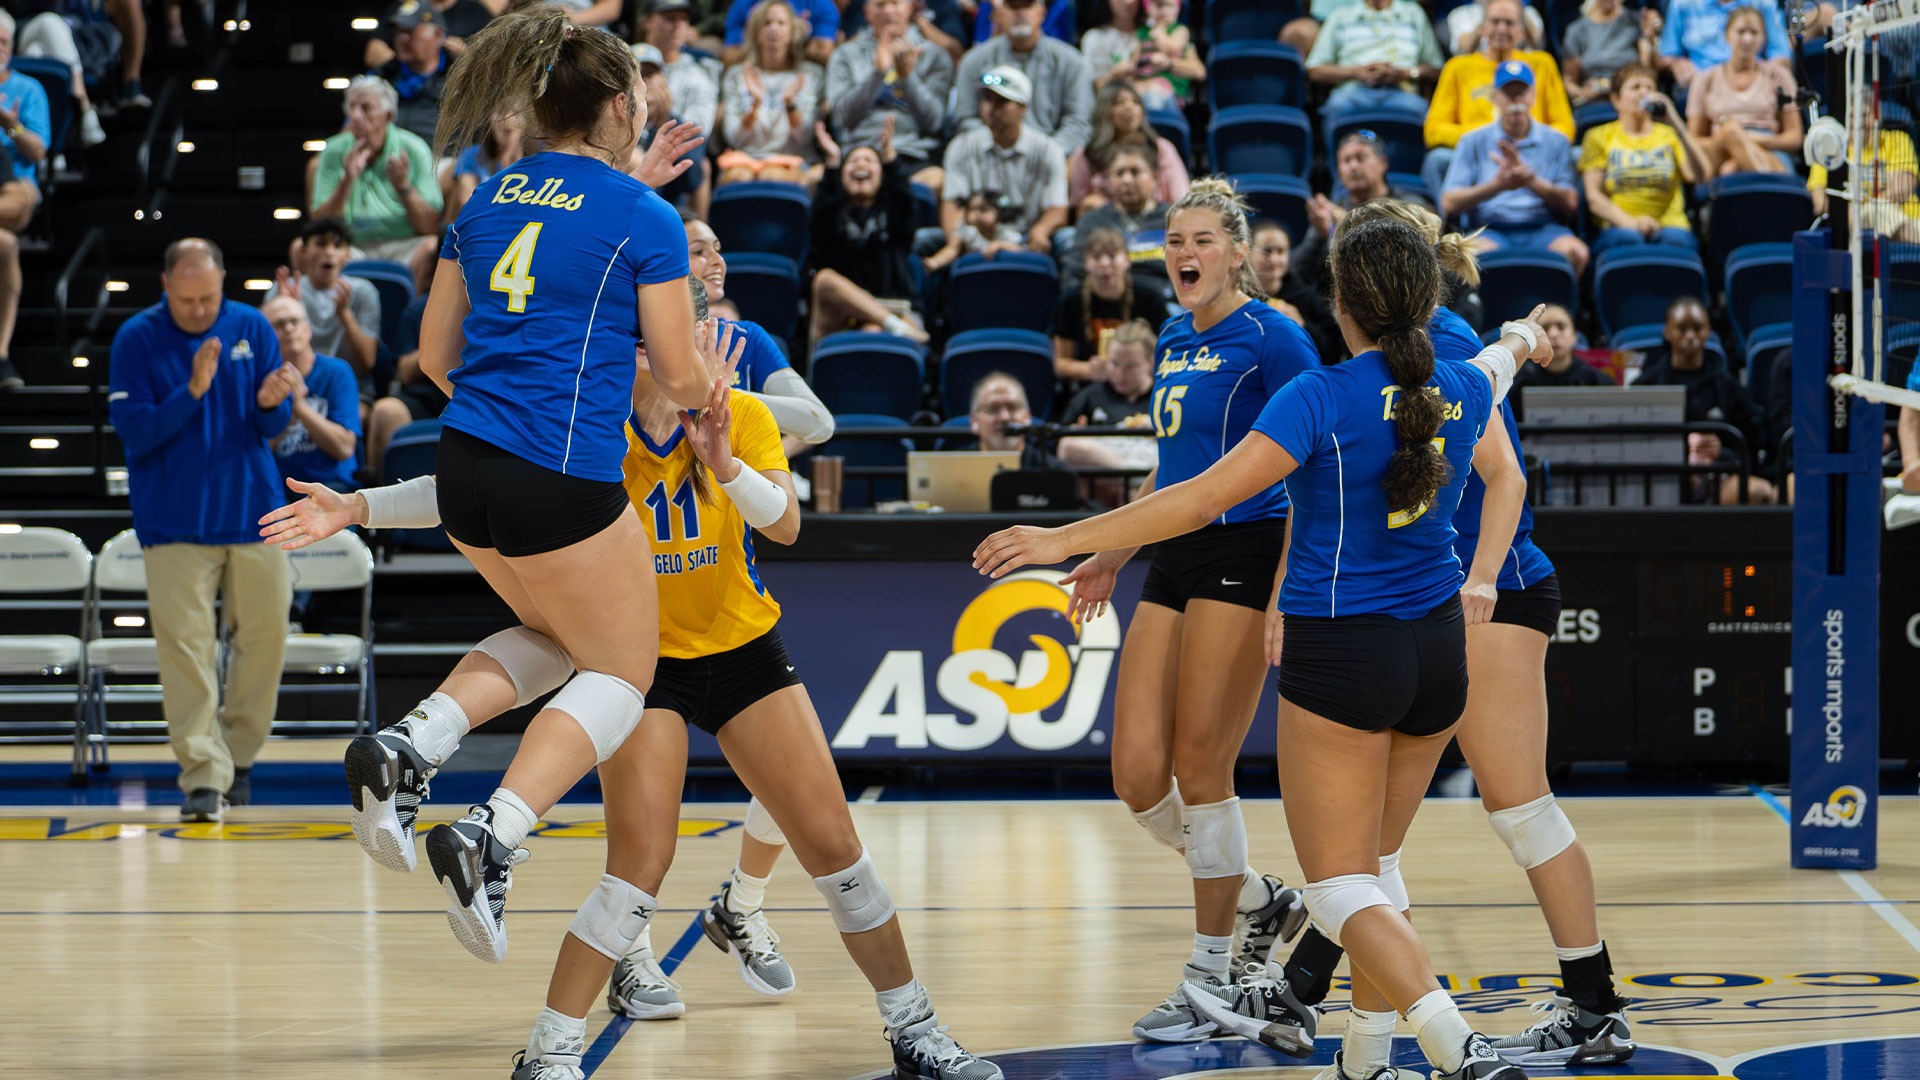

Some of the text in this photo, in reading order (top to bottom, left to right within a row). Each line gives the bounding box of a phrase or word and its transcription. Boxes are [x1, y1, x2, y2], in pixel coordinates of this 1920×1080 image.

[492, 173, 585, 211] Belles
[490, 222, 544, 313] 4
[1832, 313, 1847, 364] sports
[1153, 385, 1189, 438] 15
[643, 473, 700, 543] 11
[652, 545, 719, 575] GELO STATE
[1822, 608, 1845, 676] sports
[831, 625, 1118, 751] ASU
[1693, 667, 1716, 695] P
[1693, 707, 1716, 736] B
[1801, 797, 1867, 829] ASU
